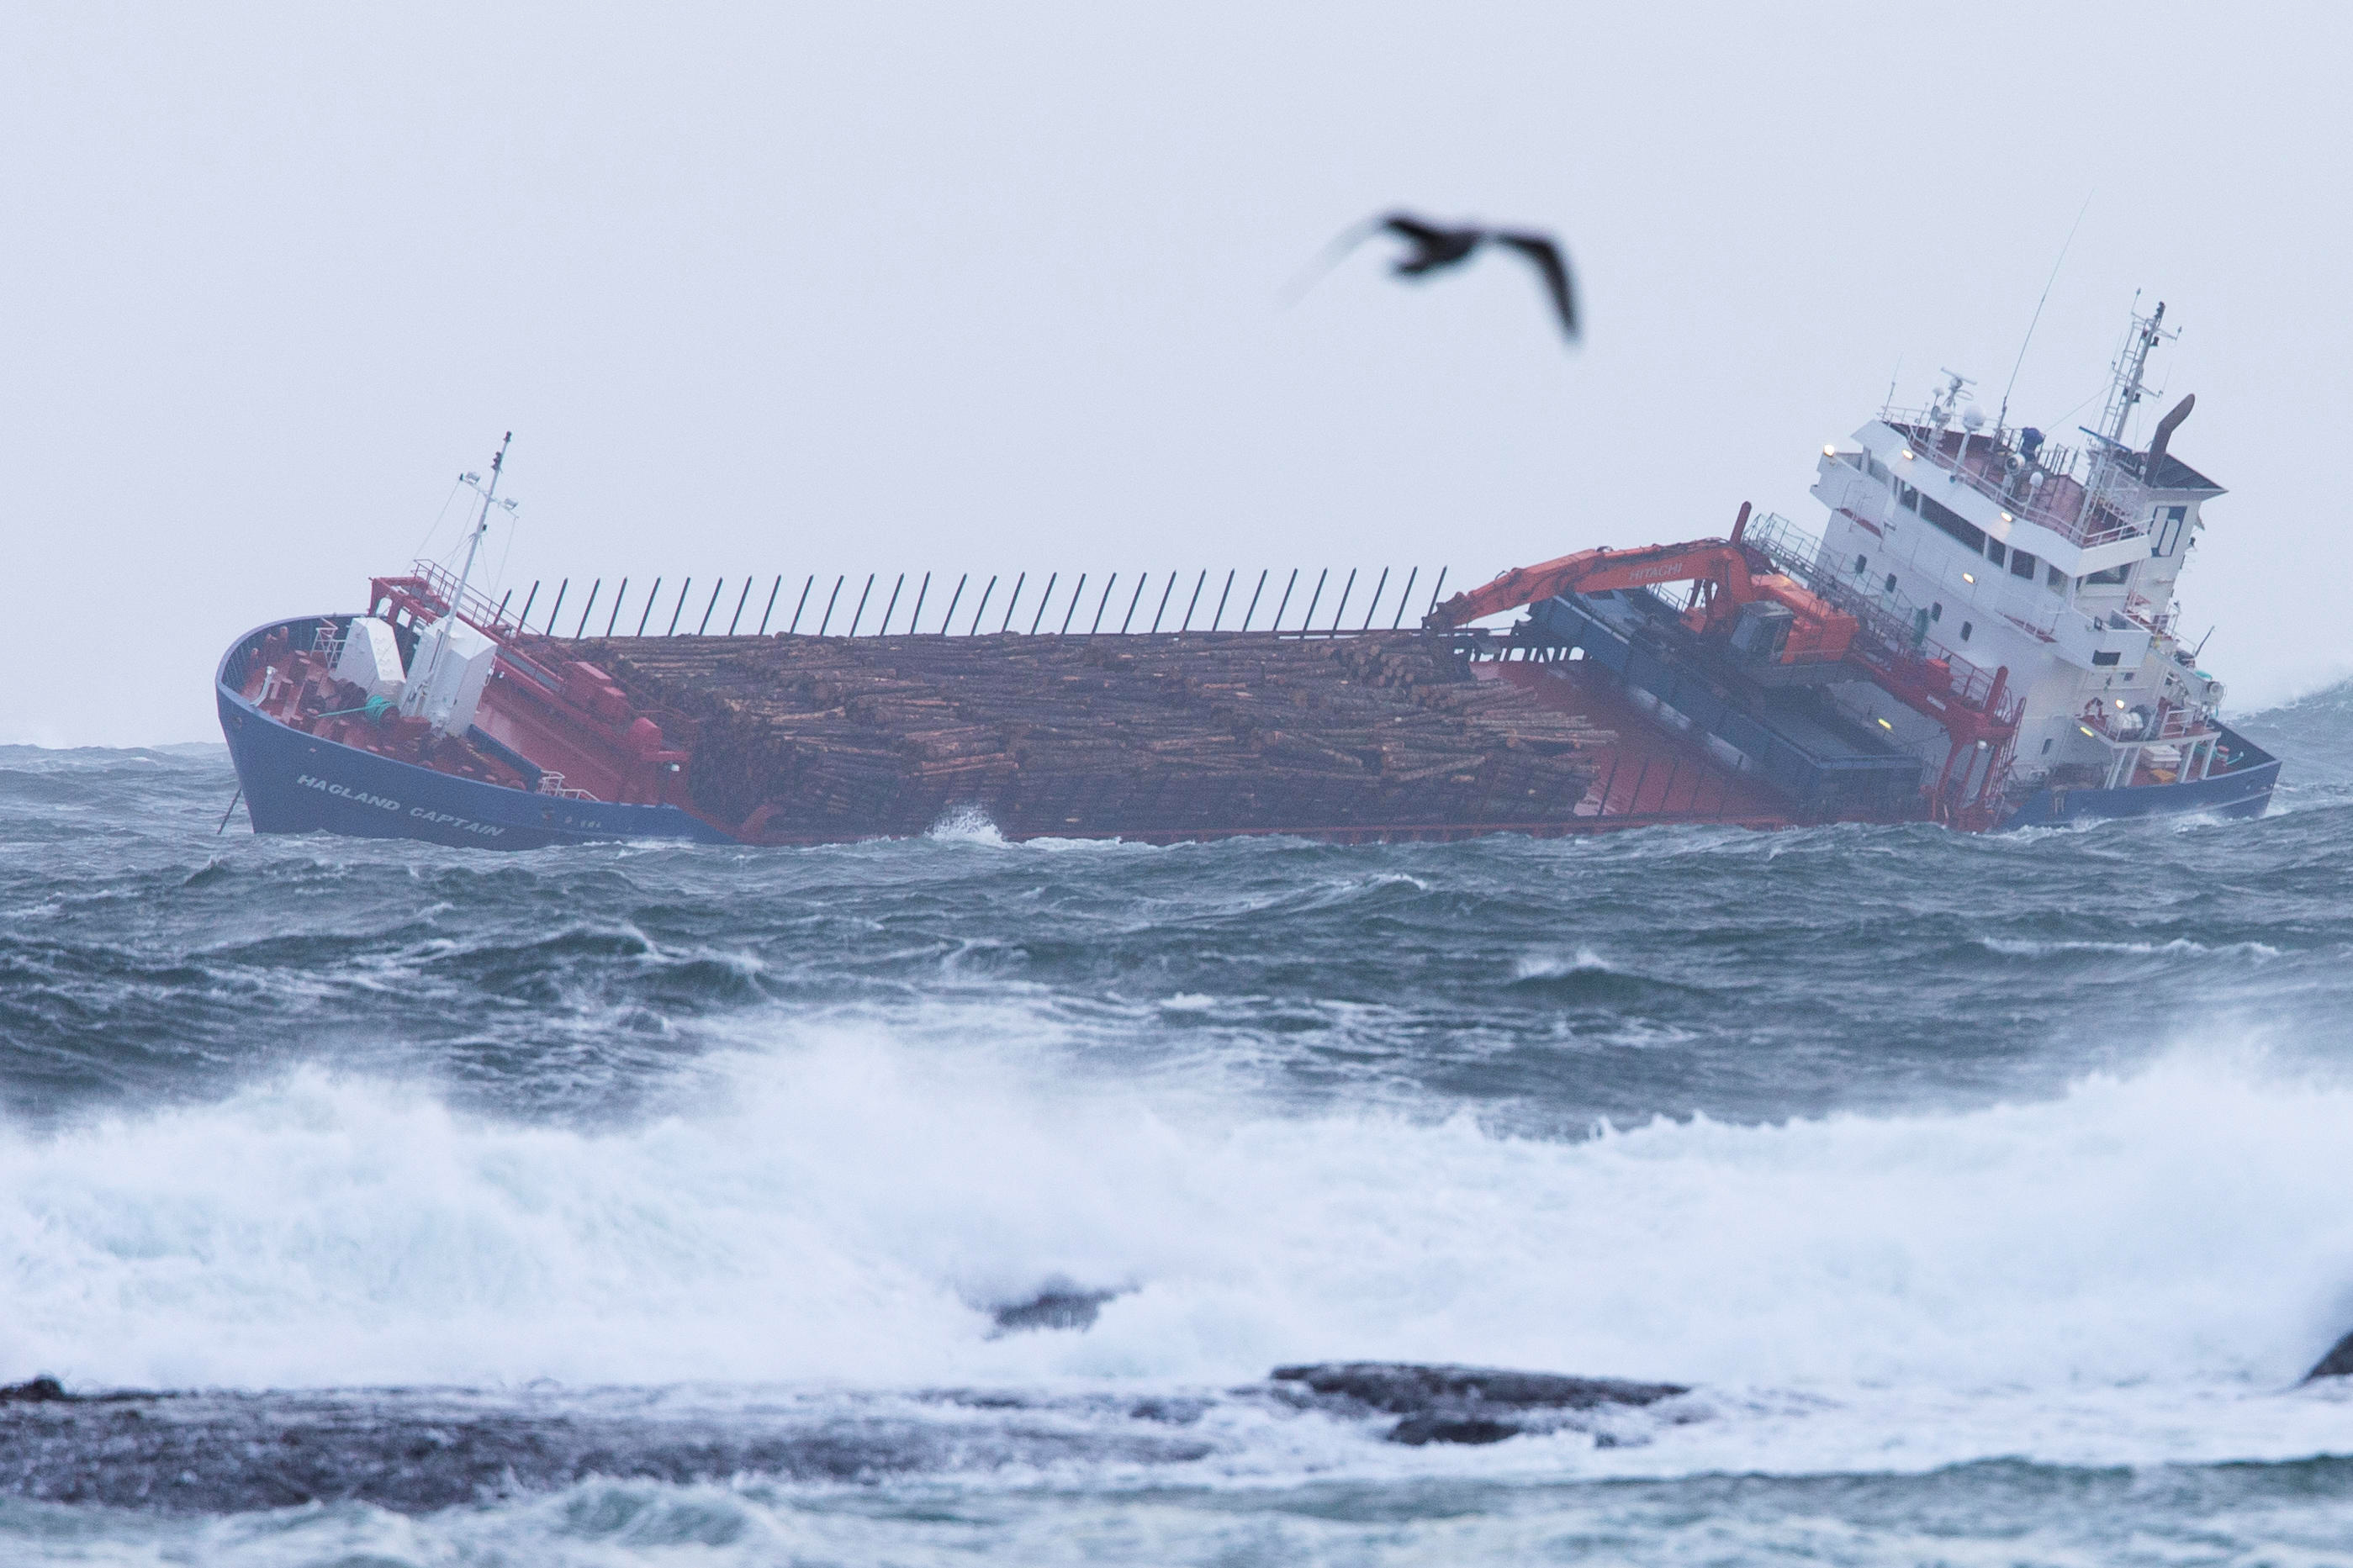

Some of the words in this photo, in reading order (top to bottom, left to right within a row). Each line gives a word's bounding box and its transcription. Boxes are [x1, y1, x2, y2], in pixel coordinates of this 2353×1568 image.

[1629, 562, 1683, 581] HITACHI
[297, 774, 400, 810] HAGLAND
[410, 807, 505, 837] CAPTAIN
